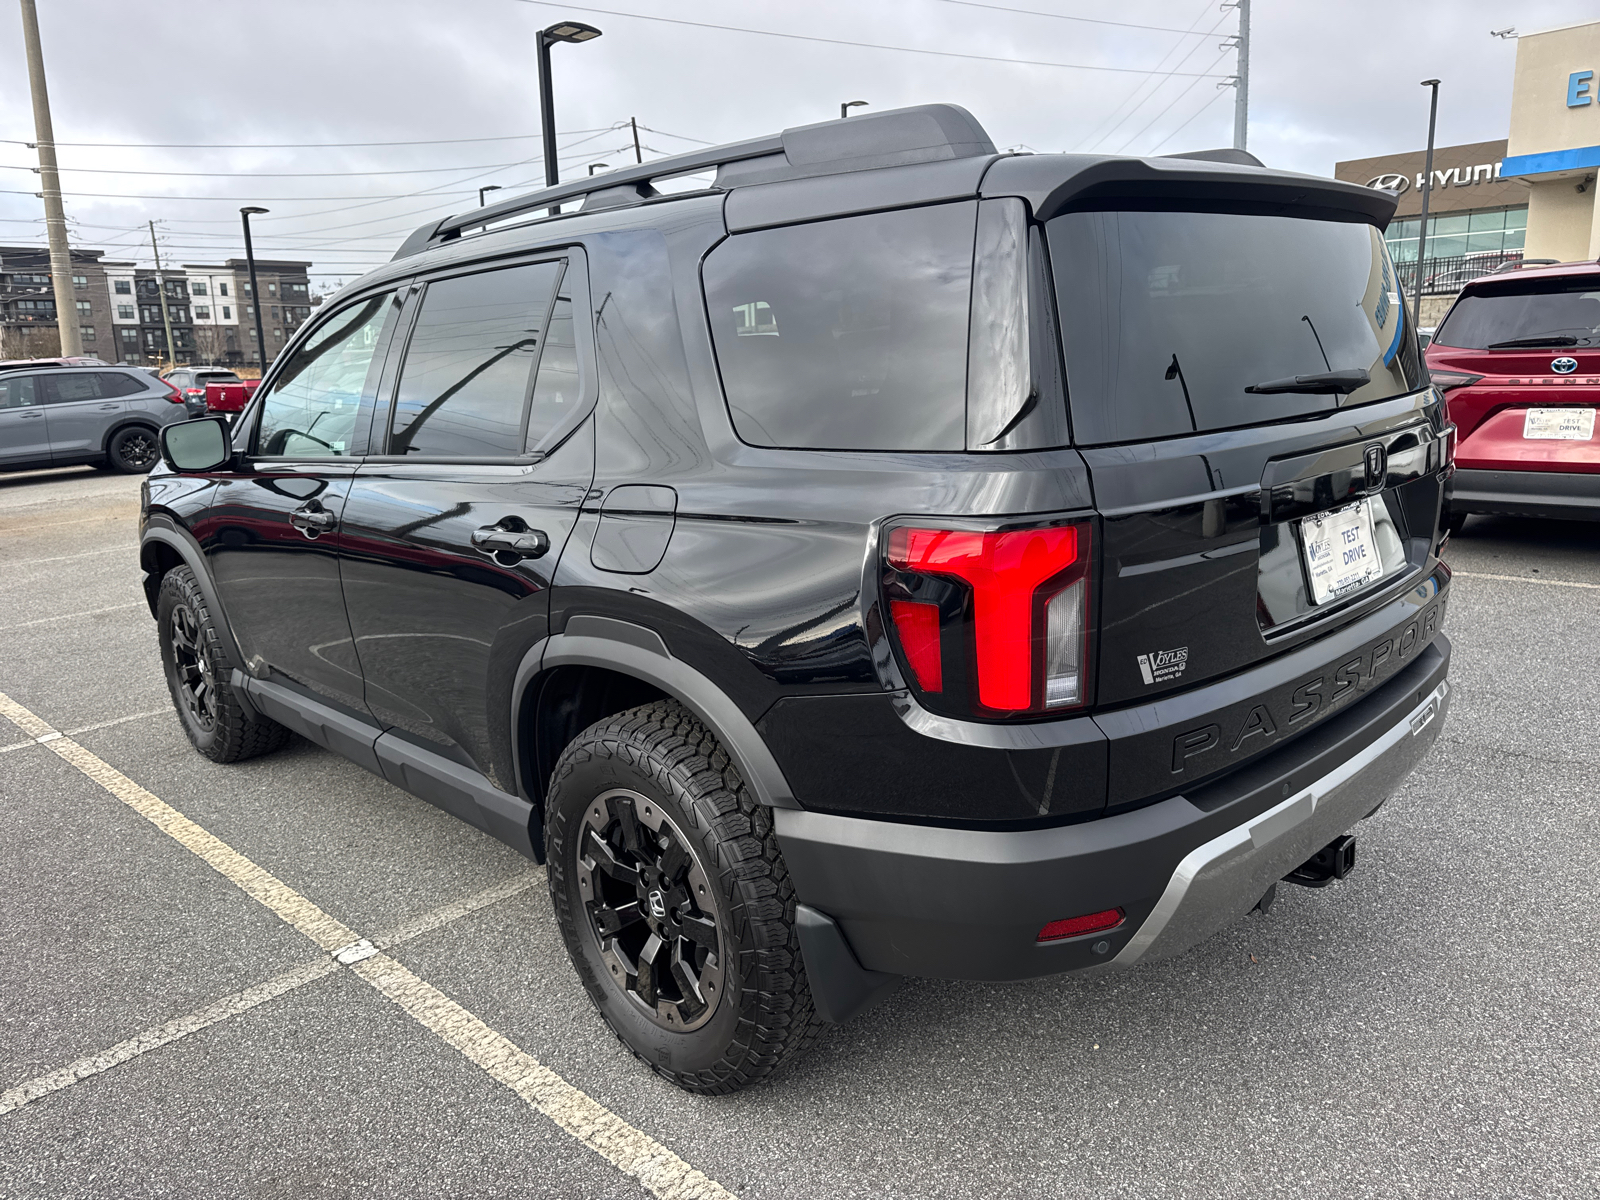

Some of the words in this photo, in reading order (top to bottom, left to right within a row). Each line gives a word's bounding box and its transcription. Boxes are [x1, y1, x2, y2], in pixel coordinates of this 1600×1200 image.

[1566, 70, 1600, 109] E
[1341, 526, 1360, 545] TEST
[1343, 544, 1367, 566] DRIVE
[1149, 649, 1187, 671] VOYLES
[1154, 666, 1179, 677] HONDA
[1171, 588, 1450, 775] PASSPORT
